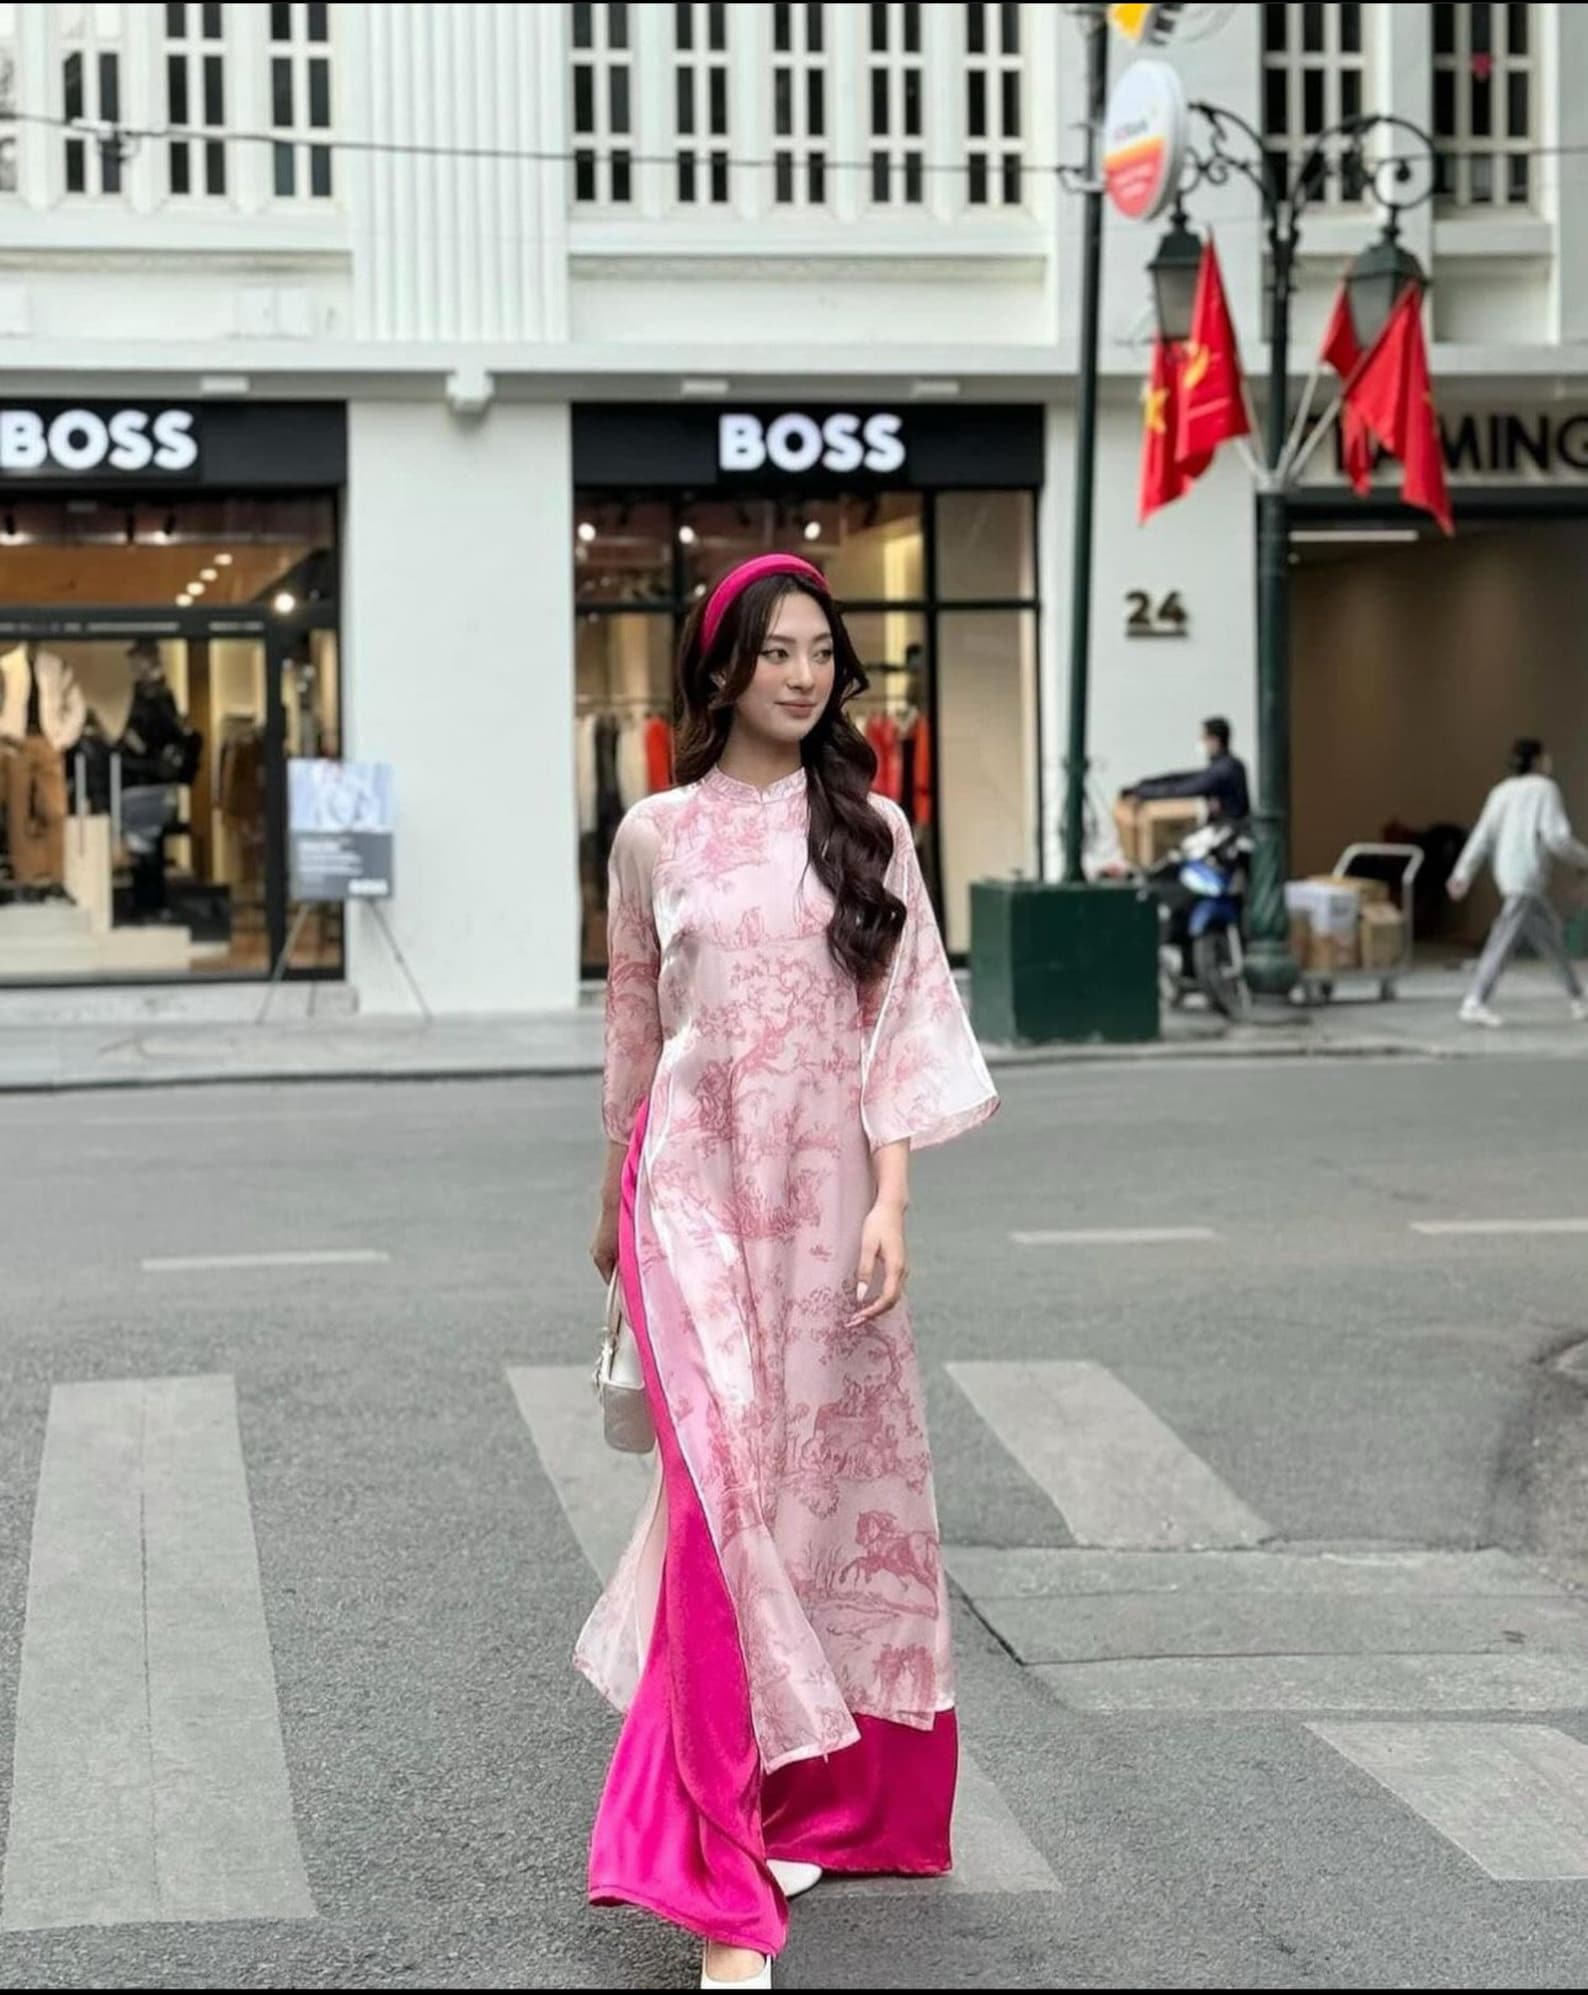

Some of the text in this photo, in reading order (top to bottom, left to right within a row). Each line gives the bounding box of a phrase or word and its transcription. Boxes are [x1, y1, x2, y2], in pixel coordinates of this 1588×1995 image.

[0, 409, 198, 470] BOSS
[718, 412, 906, 473] BOSS
[1125, 590, 1188, 624] 24
